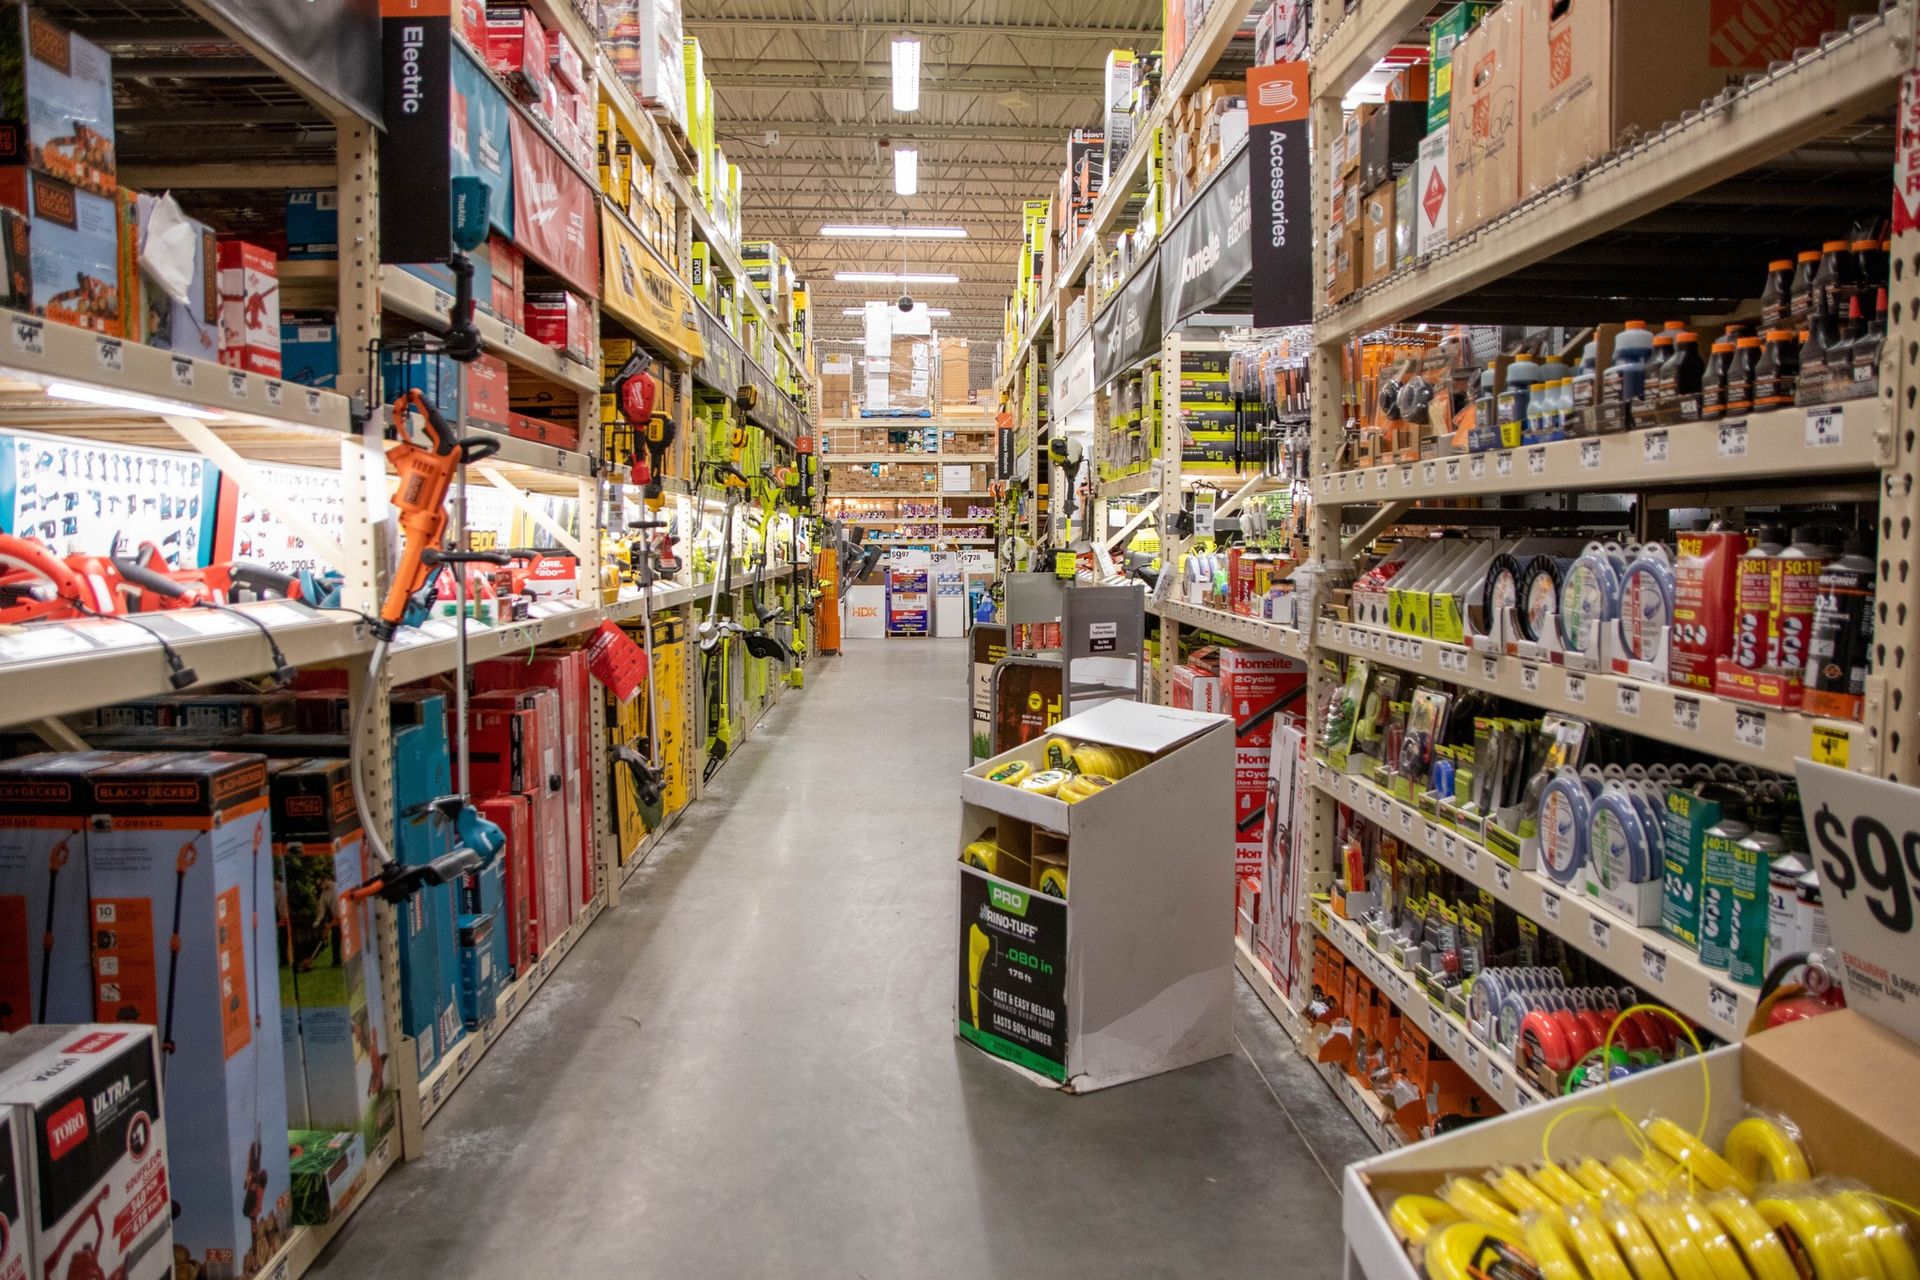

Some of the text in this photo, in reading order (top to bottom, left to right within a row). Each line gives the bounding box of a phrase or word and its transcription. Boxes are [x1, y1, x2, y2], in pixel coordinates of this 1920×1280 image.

[403, 26, 423, 114] Electric
[289, 192, 313, 204] LXT
[1269, 130, 1287, 247] Accessories
[693, 259, 702, 284] RYOBI
[291, 559, 315, 570] TOOLS
[1743, 560, 1767, 573] 50:1
[1785, 560, 1813, 574] 50:1
[852, 607, 877, 617] HDX
[1234, 658, 1292, 669] Homelite
[1671, 671, 1711, 689] TRUFUEL
[1716, 671, 1755, 686] TRUFUEL
[0, 787, 66, 798] CK+DECKER
[100, 787, 195, 798] BLACK+DECKER
[0, 819, 36, 827] ORDED
[1707, 838, 1729, 851] 40:1
[993, 888, 1022, 909] PRO
[987, 910, 1037, 938] RINO-TUFF
[1005, 948, 1053, 975] .080 in
[1842, 951, 1889, 981] EXCLUSIVE
[1008, 968, 1032, 983] 175 ft
[993, 987, 1055, 1021] FAST & EASY RELOAD
[993, 1000, 1054, 1029] MARKED EVERY FOOT
[993, 1013, 1012, 1030] LASTS
[1027, 1026, 1052, 1047] LONGER
[92, 1075, 131, 1116] ULTRA
[52, 1112, 85, 1146] TORO
[125, 1148, 163, 1194] SOUFFLEUR
